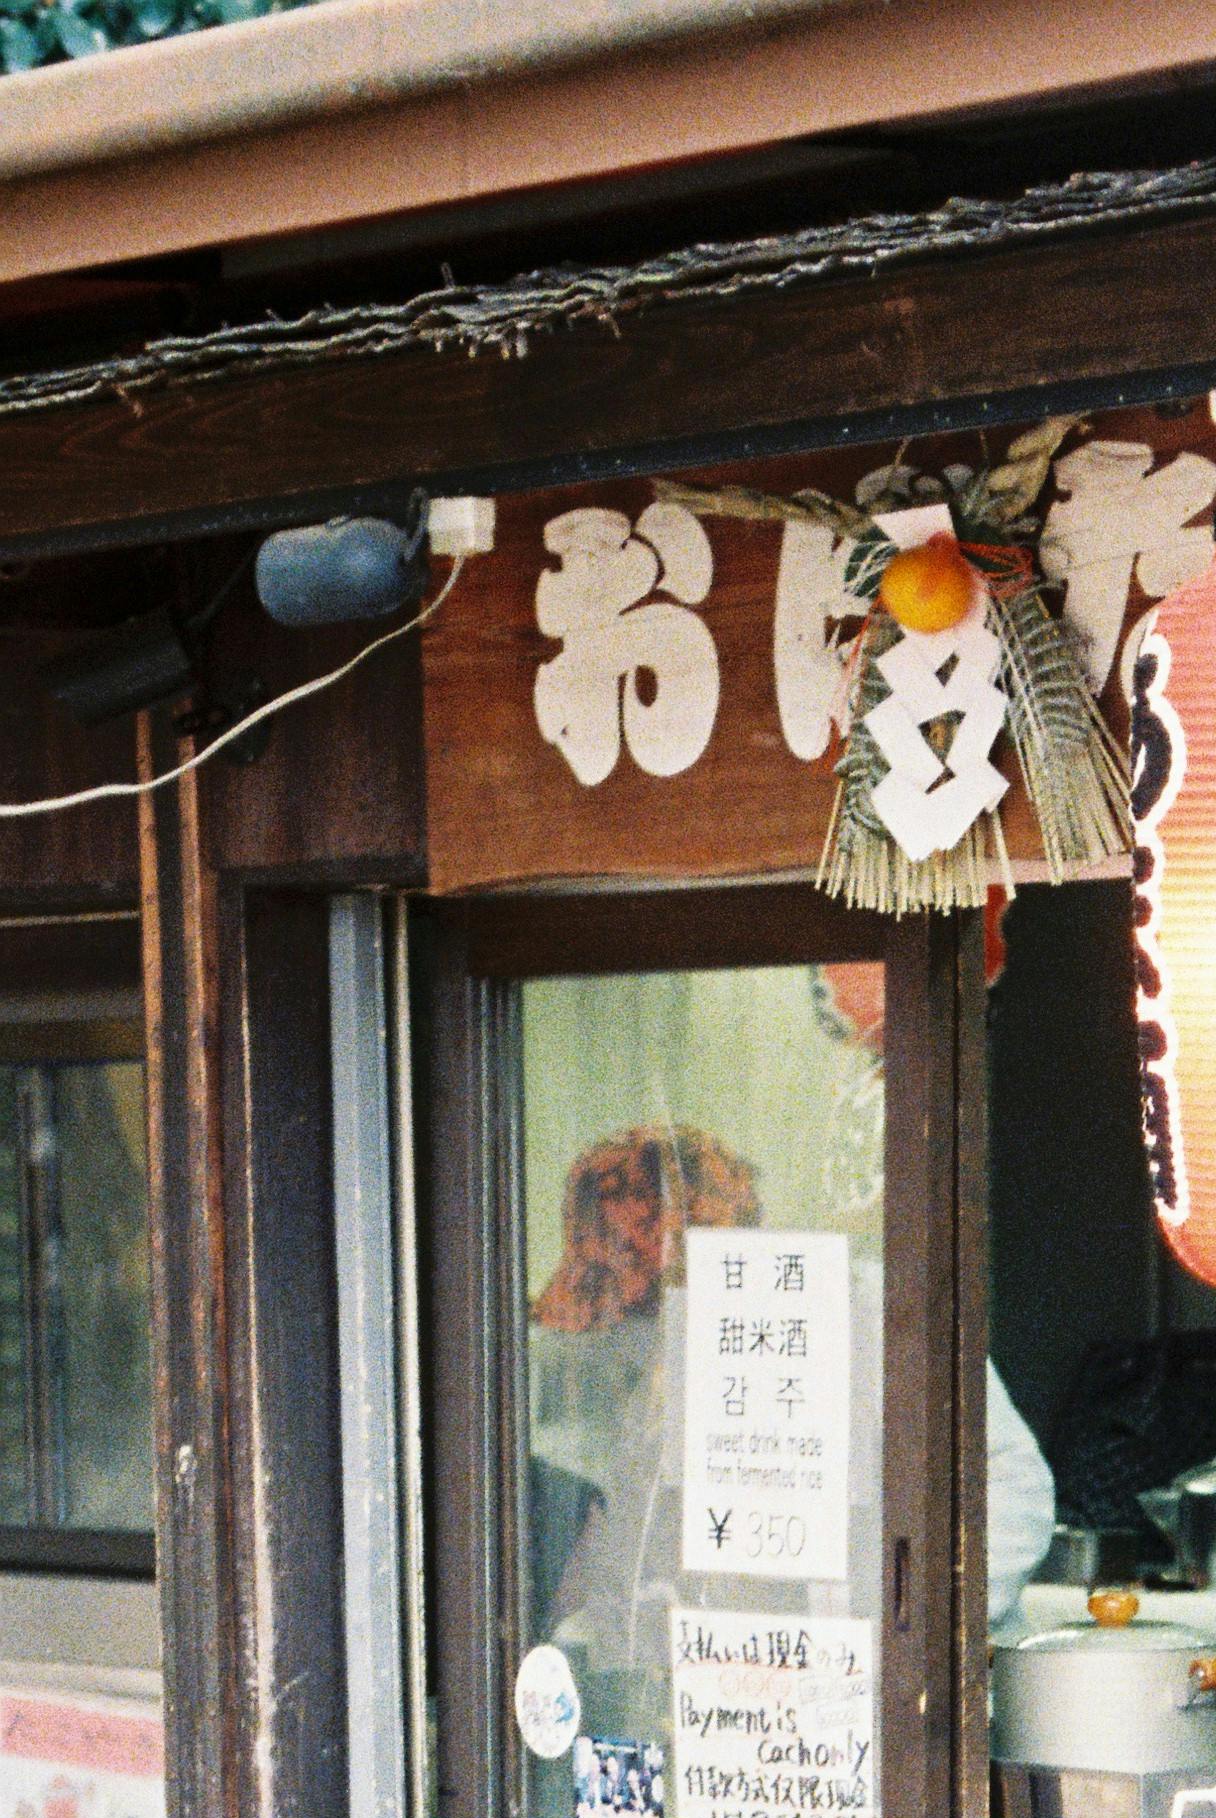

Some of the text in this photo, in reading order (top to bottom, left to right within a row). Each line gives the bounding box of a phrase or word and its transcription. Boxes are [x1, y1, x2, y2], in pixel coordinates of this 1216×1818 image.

[717, 1317, 809, 1359] 甜米酒
[679, 1690, 798, 1738] Payment is
